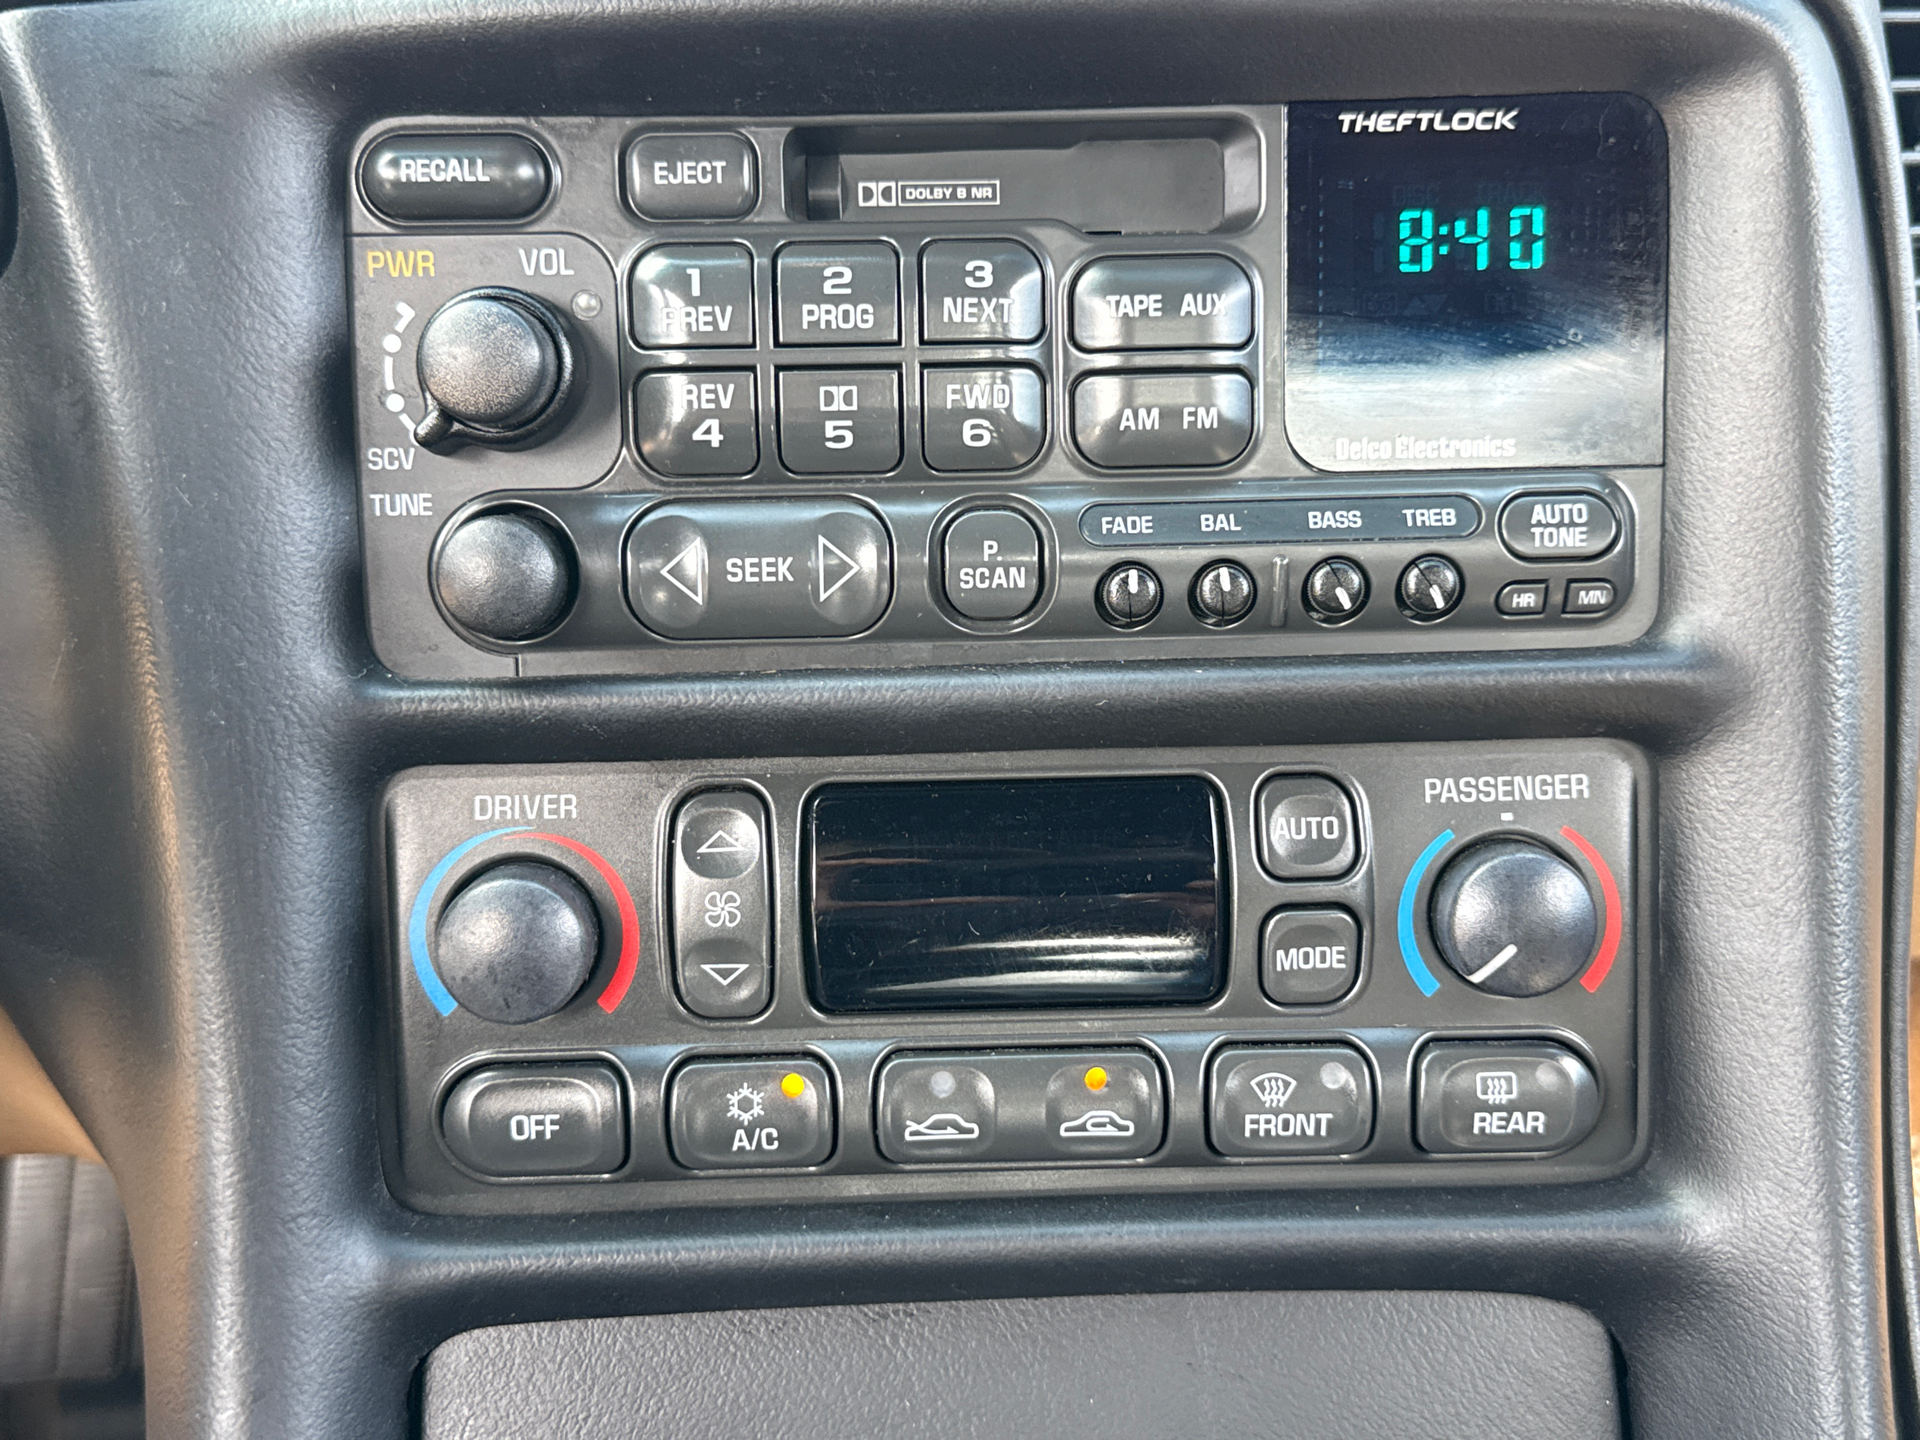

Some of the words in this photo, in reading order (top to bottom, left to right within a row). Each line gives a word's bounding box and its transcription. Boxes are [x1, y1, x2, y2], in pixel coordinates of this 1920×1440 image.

[1338, 108, 1519, 133] THEFTLOCK
[400, 158, 490, 182] RECALL
[654, 161, 726, 185] EJECT
[905, 187, 954, 200] DOLBY
[956, 187, 967, 199] B
[971, 186, 993, 199] NR
[1399, 206, 1546, 273] 8:40
[367, 250, 436, 277] PWR
[519, 248, 575, 276] VOL
[964, 260, 994, 288] 3
[686, 268, 701, 297] 1
[823, 266, 852, 295] 2
[802, 304, 874, 329] PROG
[943, 297, 1014, 323] NEXT
[1106, 294, 1162, 318] TAPE
[1180, 293, 1227, 316] AUX
[661, 305, 733, 332] PREV
[681, 384, 736, 410] REV
[946, 385, 1010, 410] FWD
[1119, 409, 1160, 431] AM
[1182, 407, 1219, 430] FM
[692, 418, 724, 448] 4
[824, 420, 854, 449] 5
[962, 418, 992, 447] 6
[367, 447, 415, 471] SCV
[1335, 438, 1392, 461] Delco
[1395, 436, 1516, 460] Electronics
[370, 493, 432, 516] TUNE
[1530, 504, 1588, 525] AUTO
[1100, 516, 1153, 535] FADE
[1199, 514, 1242, 533] BAL
[1307, 510, 1363, 529] BASS
[1402, 508, 1457, 528] TREB
[1531, 526, 1588, 548] TONE
[982, 540, 1004, 562] P.
[725, 557, 795, 582] SEEK
[959, 567, 1026, 589] SCAN
[1511, 593, 1536, 609] HR
[1577, 589, 1607, 605] MN
[1423, 773, 1590, 804] PASSENGER
[473, 794, 578, 821] DRIVER
[1272, 815, 1340, 841] AUTO
[1275, 945, 1347, 971] MODE
[509, 1114, 560, 1141] OFF
[1243, 1113, 1333, 1138] FRONT
[1472, 1110, 1545, 1135] REAR
[731, 1127, 780, 1152] A/C
